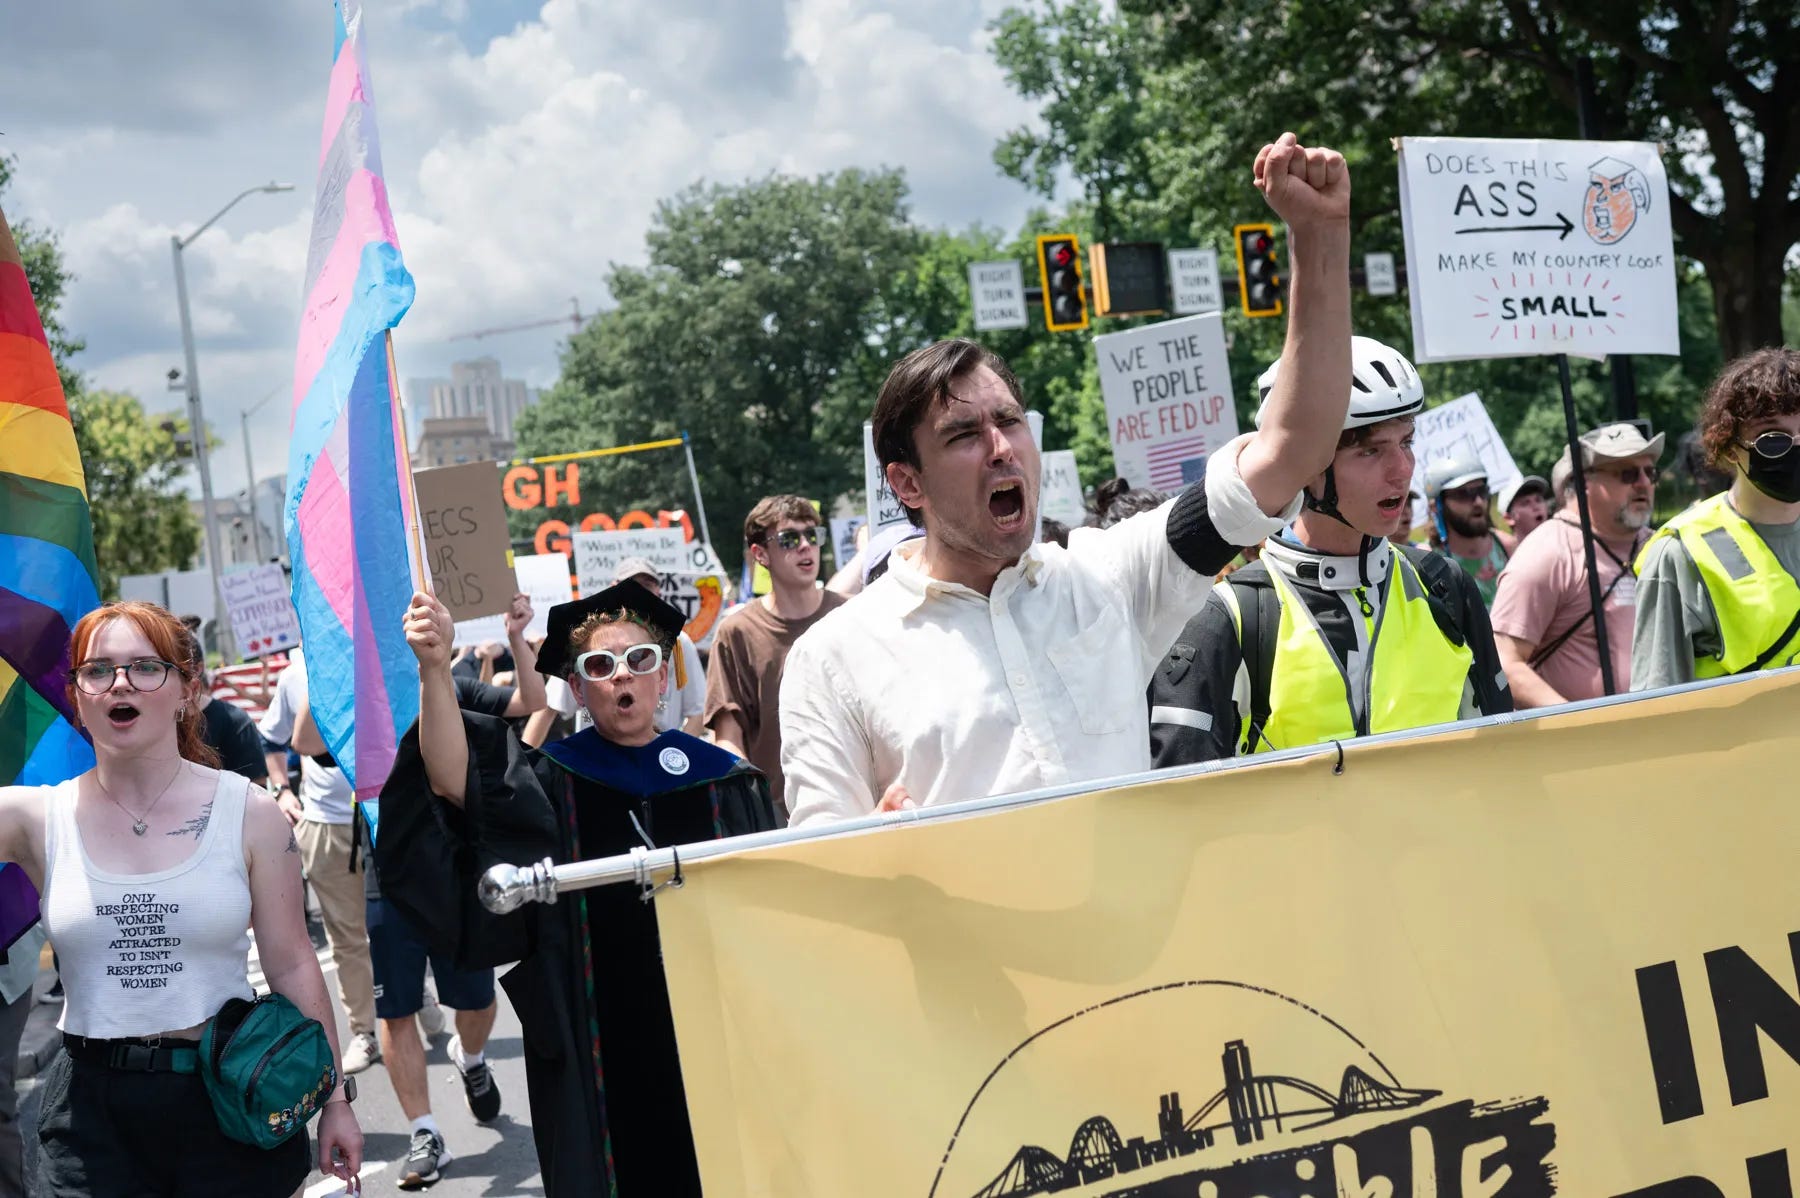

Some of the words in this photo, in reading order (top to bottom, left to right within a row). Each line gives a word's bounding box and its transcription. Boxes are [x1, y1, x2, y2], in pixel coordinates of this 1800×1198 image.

[1426, 153, 1495, 175] DOES
[1503, 159, 1568, 182] THIS
[1454, 181, 1538, 217] ASS
[1438, 252, 1497, 272] MAKE
[1513, 251, 1537, 269] MY
[1544, 254, 1621, 269] COUNTRY
[1628, 254, 1663, 268] LOOK
[979, 269, 1011, 285] RIGHT
[1182, 275, 1211, 288] TURN
[982, 288, 1014, 303] TURN
[980, 306, 1020, 321] SIGNAL
[1501, 296, 1607, 320] SMALL
[1110, 346, 1147, 374] WE
[1158, 334, 1202, 363] THE
[1132, 365, 1208, 405] PEOPLE
[1116, 411, 1152, 444] ARE
[1158, 402, 1198, 435] FED
[1201, 395, 1225, 425] UP
[503, 463, 580, 510] GH
[122, 893, 156, 904] ONLY
[96, 903, 179, 916] RESPECTING
[113, 914, 164, 926] WOMEN
[120, 925, 166, 937] YOU'RE
[108, 937, 181, 949] ATTRACTED
[120, 952, 136, 961] TO
[140, 950, 171, 961] ISN'T
[106, 962, 183, 976] RESPECTING
[120, 977, 168, 989] WOMEN
